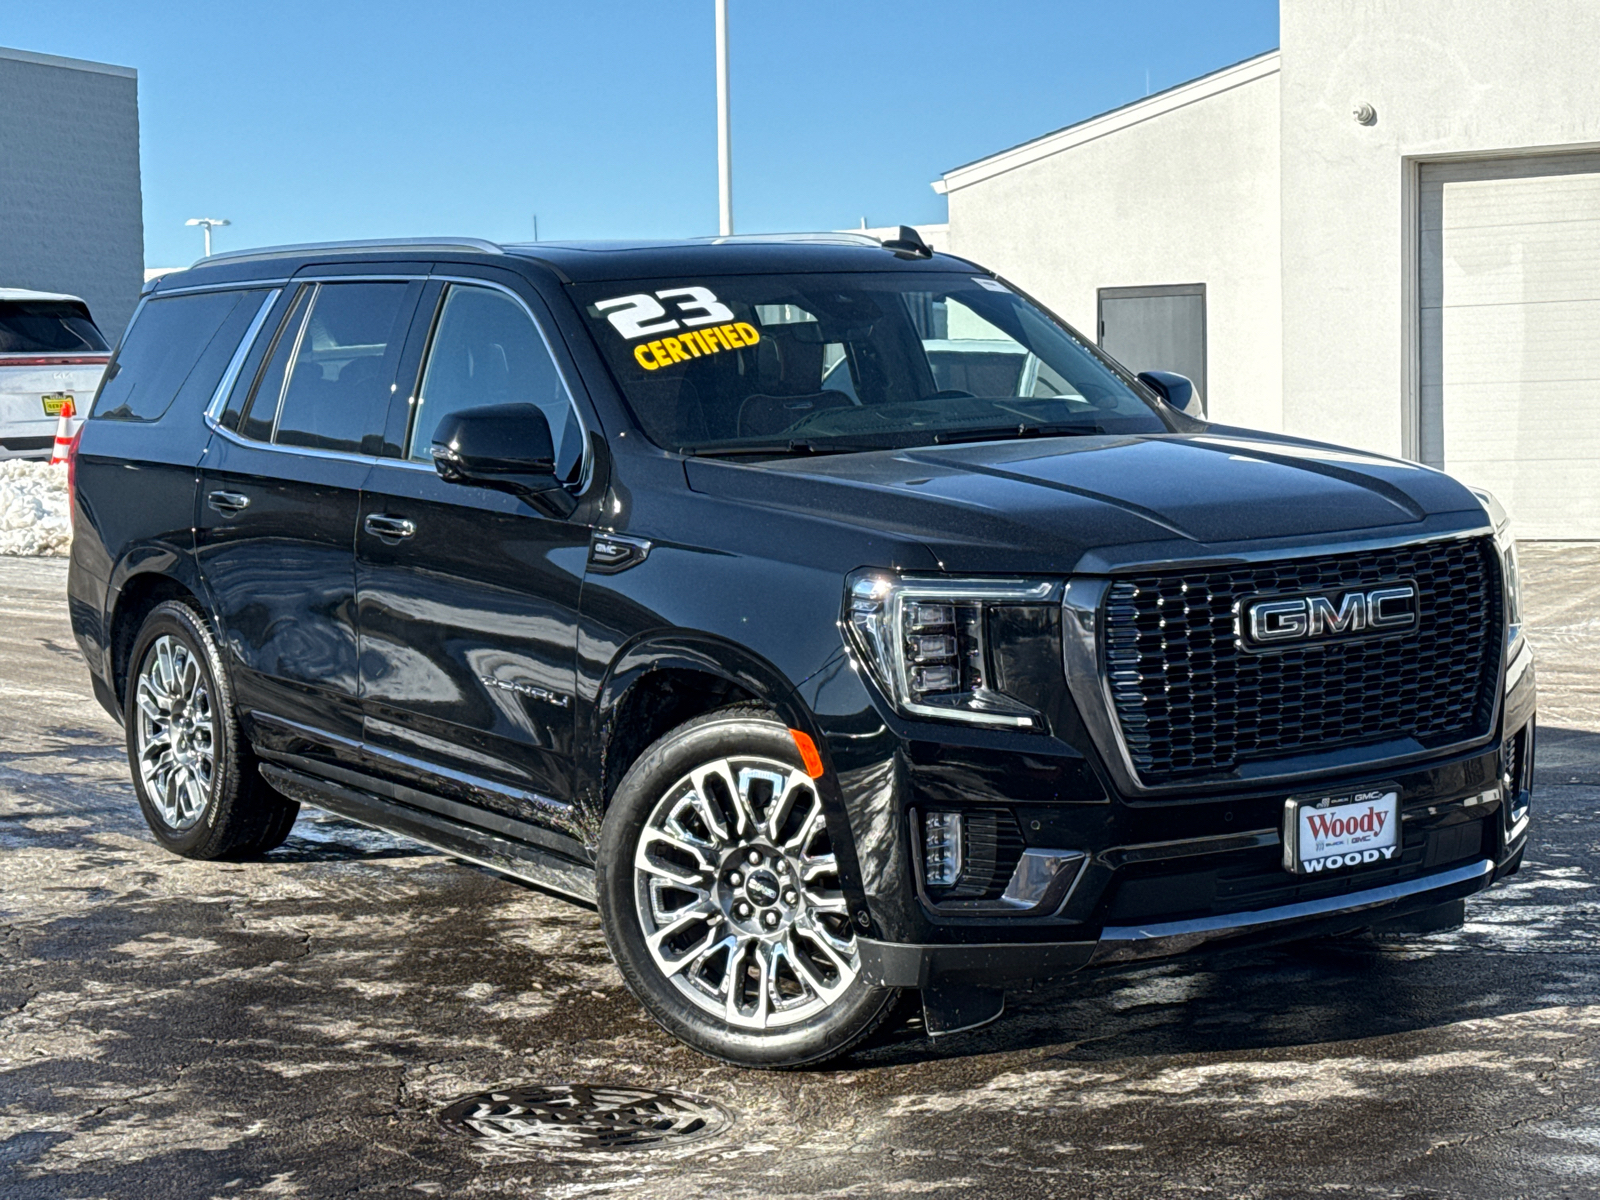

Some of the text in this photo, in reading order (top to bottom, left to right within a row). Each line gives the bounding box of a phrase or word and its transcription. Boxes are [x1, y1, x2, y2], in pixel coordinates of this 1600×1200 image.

[594, 286, 735, 339] 23
[634, 322, 760, 371] CERTIFIED
[595, 543, 617, 555] GMC
[1250, 587, 1415, 642] GMC
[1354, 791, 1380, 802] GMC
[1306, 806, 1389, 841] Woody
[1351, 835, 1371, 844] GMC
[1303, 846, 1397, 874] WOODY
